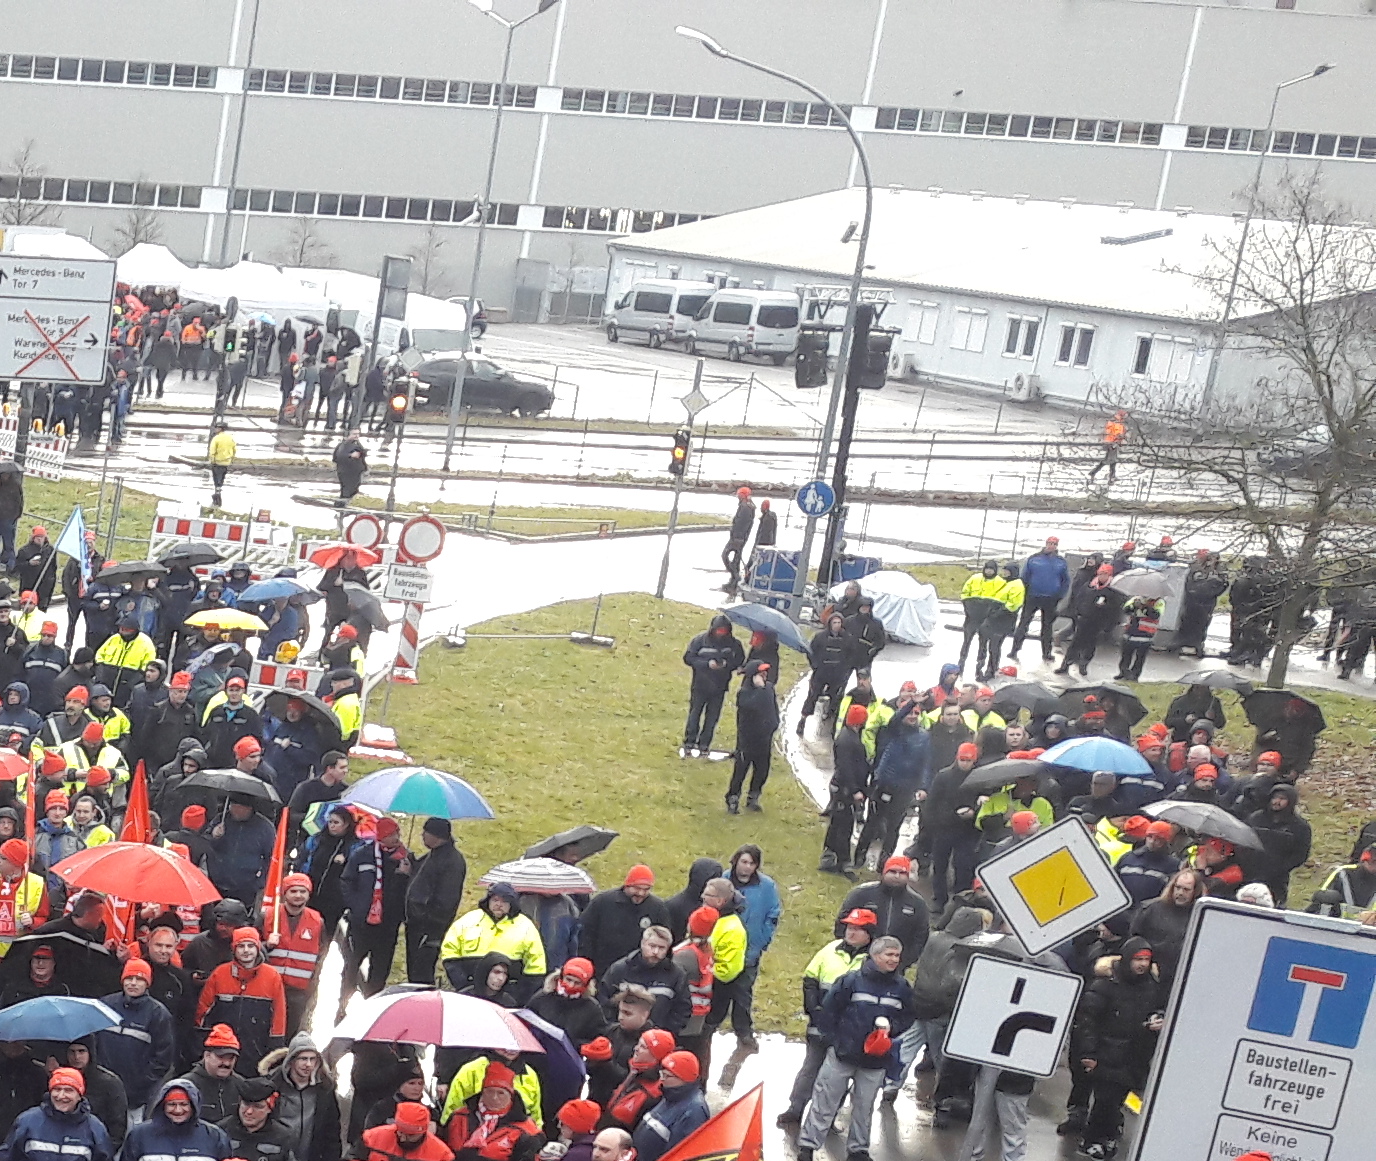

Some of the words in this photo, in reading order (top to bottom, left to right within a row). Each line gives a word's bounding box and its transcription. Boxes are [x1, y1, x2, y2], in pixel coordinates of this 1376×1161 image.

[13, 279, 26, 289] Tor
[32, 280, 38, 289] 7
[8, 314, 50, 325] Mercdes
[1246, 1049, 1337, 1078] Baustellen-
[1248, 1070, 1325, 1100] fahrzeuge
[1263, 1094, 1300, 1115] frei
[1247, 1126, 1298, 1148] Keine
